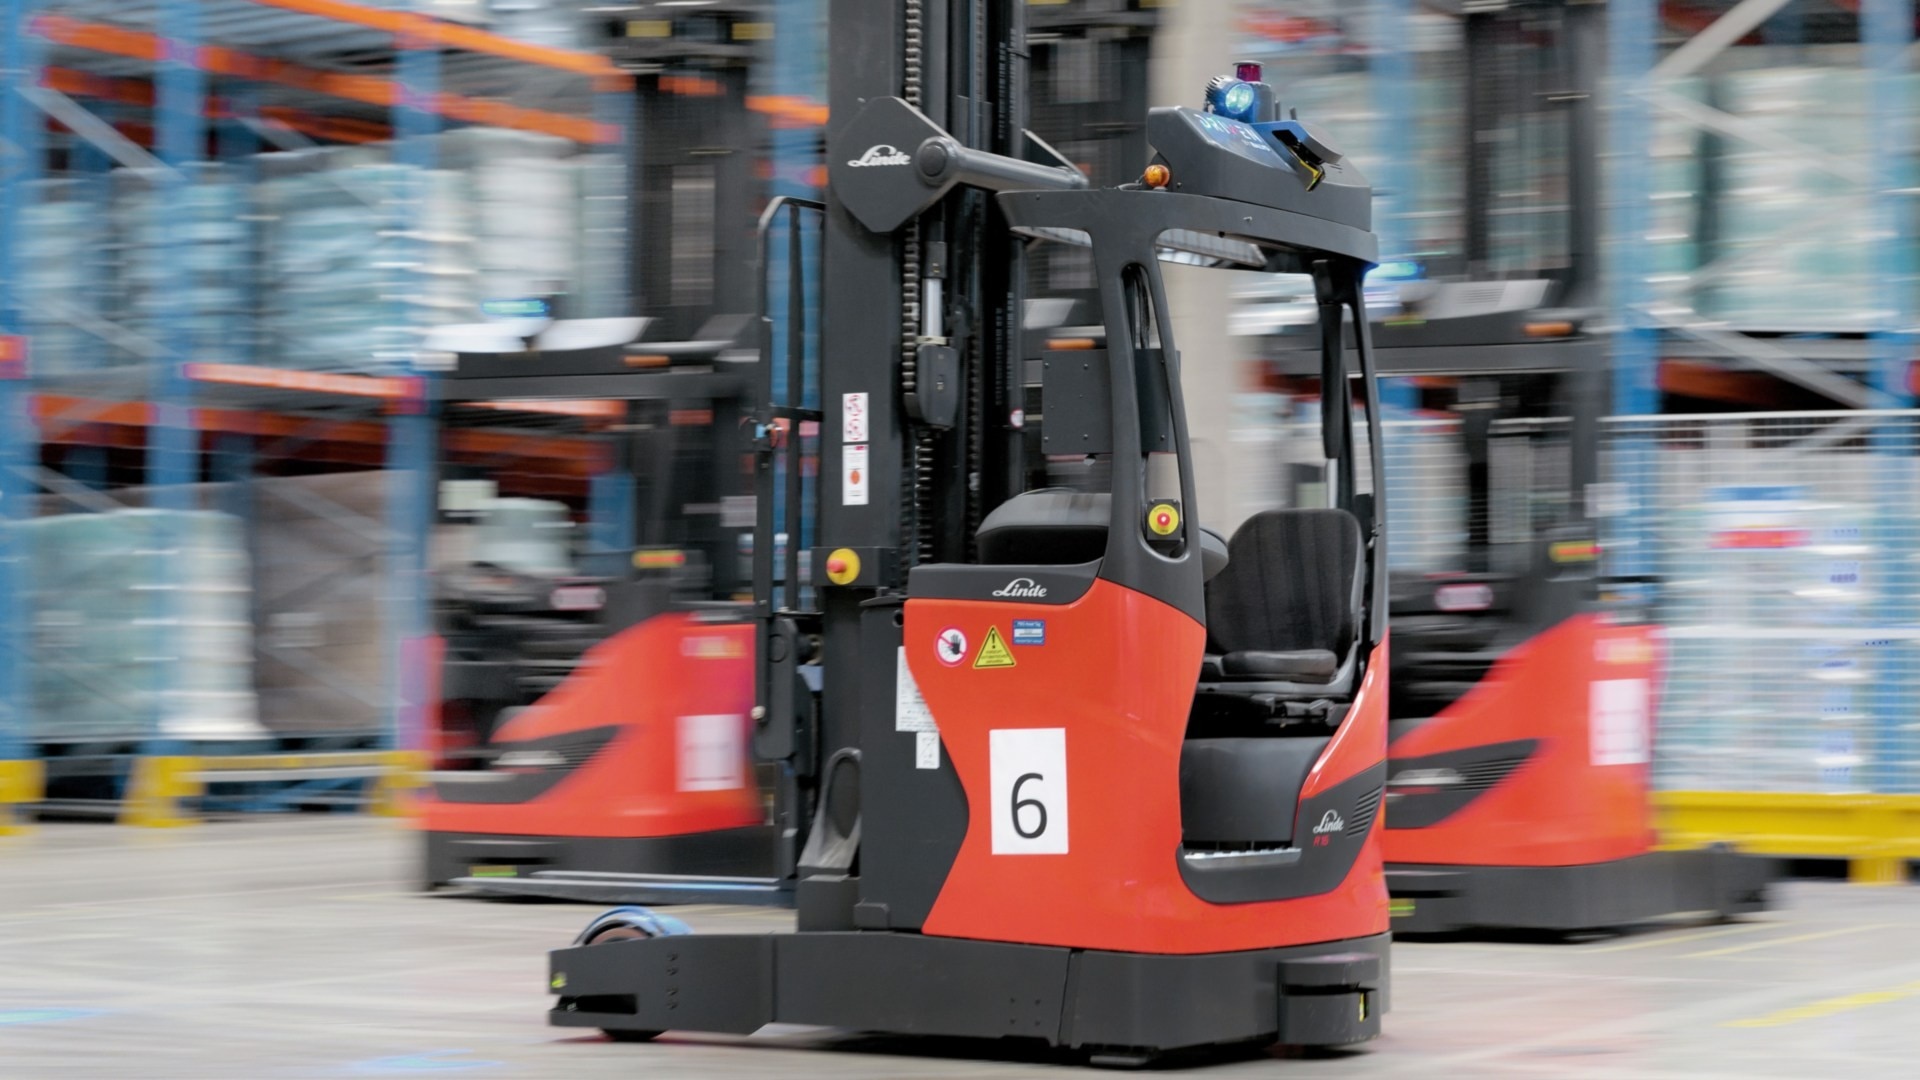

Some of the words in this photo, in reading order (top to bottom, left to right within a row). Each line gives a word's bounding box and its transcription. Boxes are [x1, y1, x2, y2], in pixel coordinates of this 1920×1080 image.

[846, 144, 912, 167] Linde
[992, 577, 1048, 597] Linde
[1010, 772, 1048, 839] 6
[1312, 809, 1345, 834] Linde
